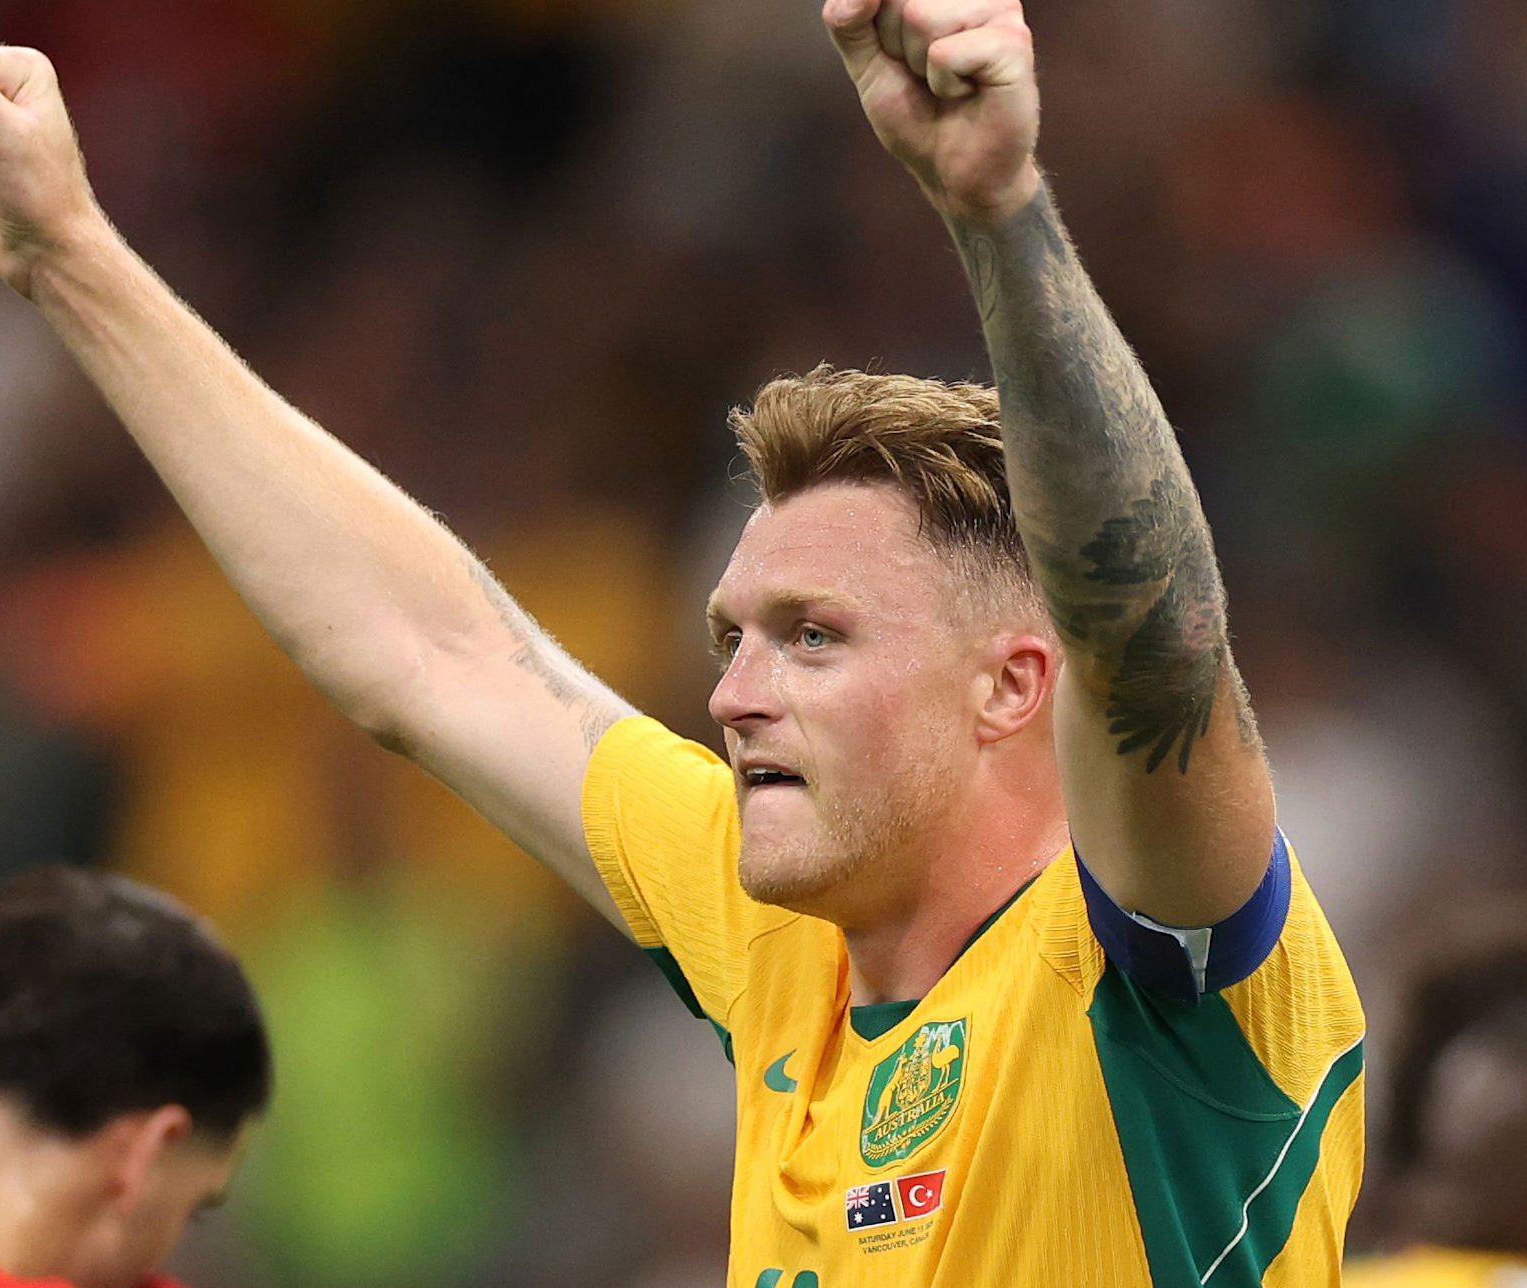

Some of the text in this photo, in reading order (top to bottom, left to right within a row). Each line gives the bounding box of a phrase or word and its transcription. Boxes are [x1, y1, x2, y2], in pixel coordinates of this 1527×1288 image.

[874, 1091, 945, 1142] AUSTRALIA
[858, 1231, 896, 1245] SATURDAY
[897, 1227, 916, 1237] JUNE
[862, 1239, 909, 1254] VANCOUVER,
